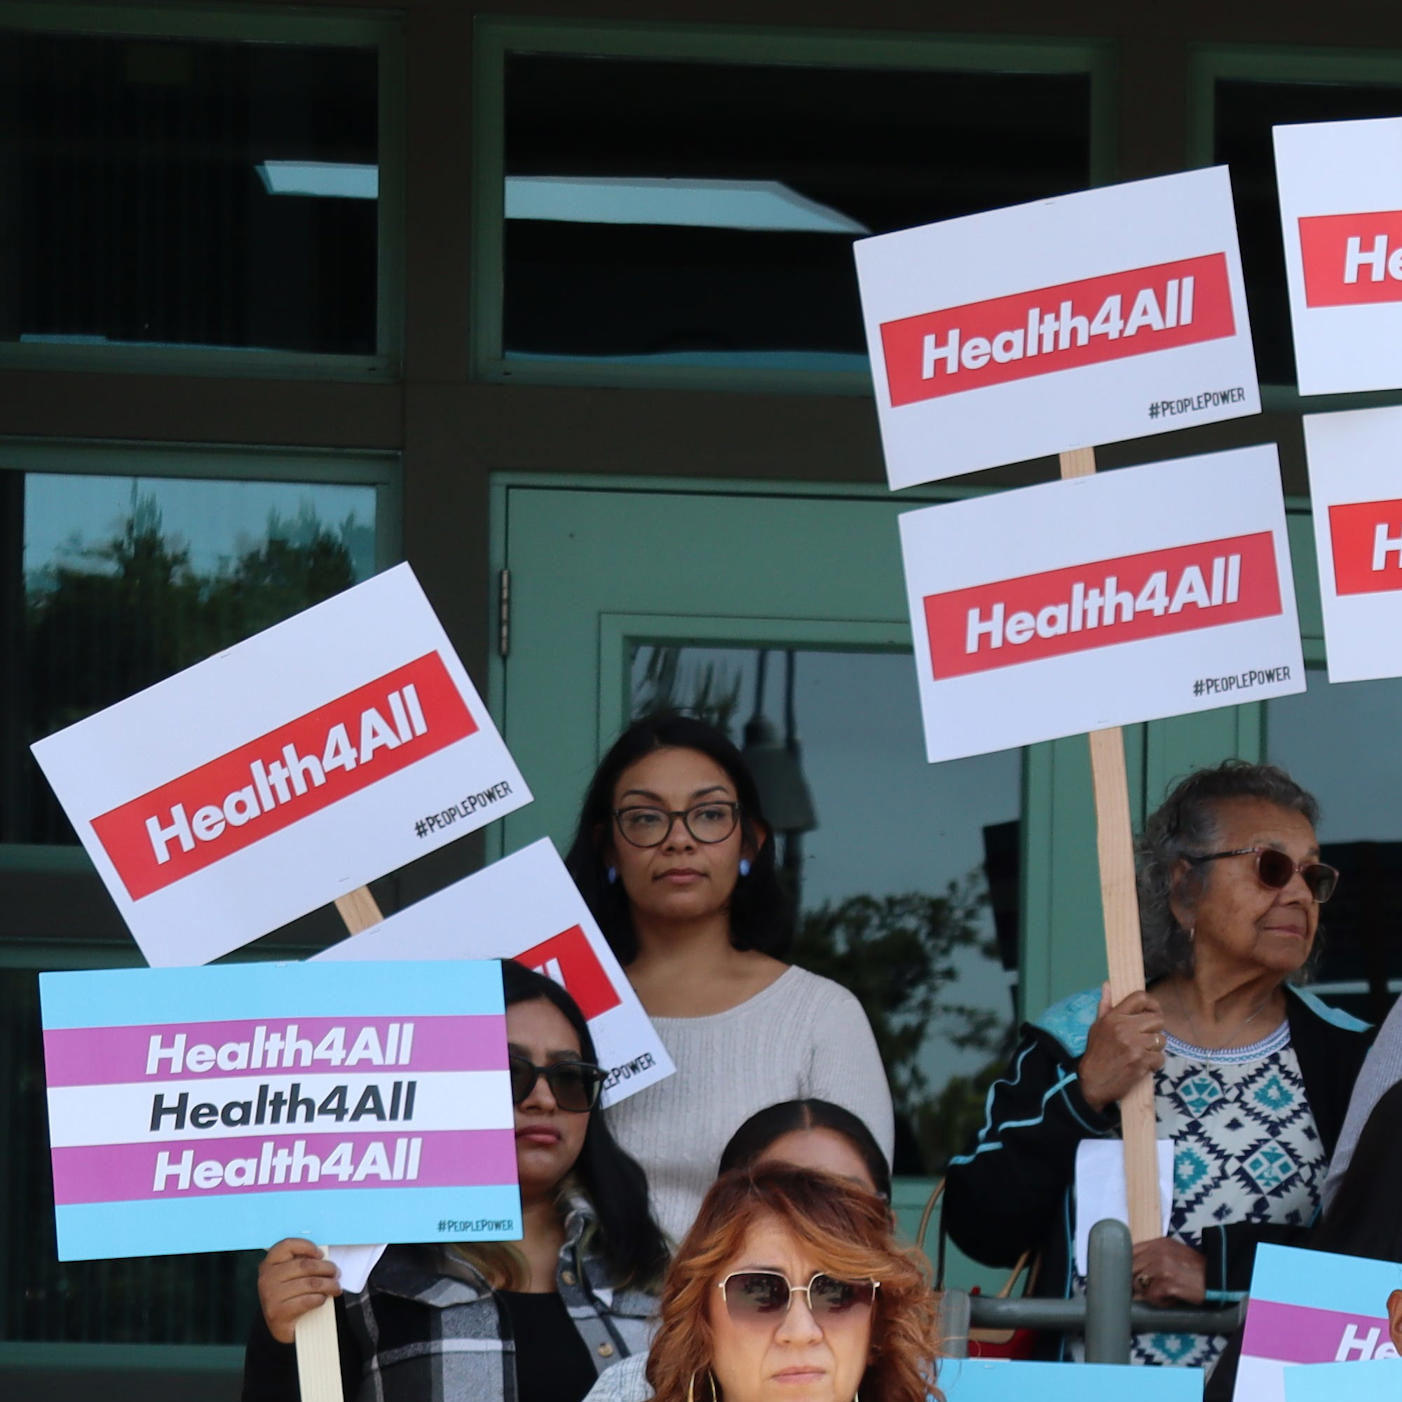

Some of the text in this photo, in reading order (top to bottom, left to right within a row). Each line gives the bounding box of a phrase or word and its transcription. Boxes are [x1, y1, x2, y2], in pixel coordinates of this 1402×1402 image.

[921, 275, 1195, 380] Health4All
[1148, 386, 1246, 420] #PEOPLEPOWER
[964, 553, 1242, 654] Health4All
[1192, 665, 1292, 697] #PEOPLEPOWER
[144, 683, 428, 865] Health4All
[413, 779, 513, 839] #PEOPLEPOWER
[145, 1023, 414, 1076] Health4All
[149, 1081, 417, 1132] Health4All
[152, 1137, 423, 1193] Health4All
[437, 1218, 514, 1234] #PEOPLEPOWER
